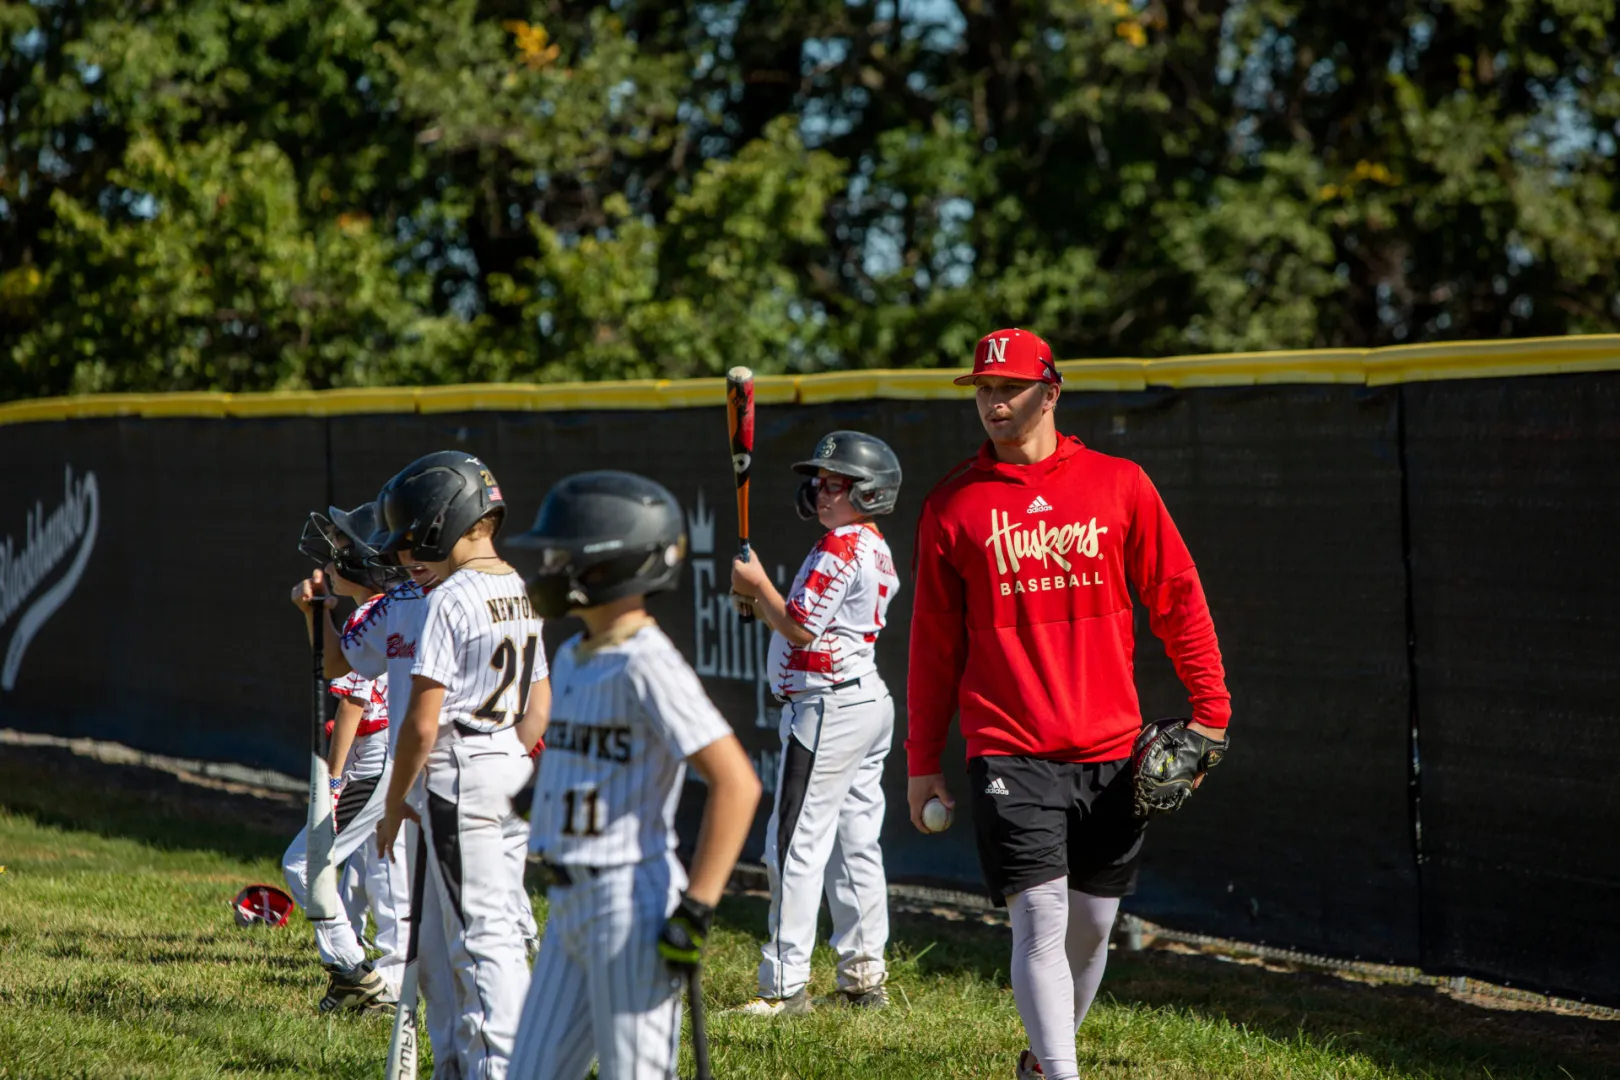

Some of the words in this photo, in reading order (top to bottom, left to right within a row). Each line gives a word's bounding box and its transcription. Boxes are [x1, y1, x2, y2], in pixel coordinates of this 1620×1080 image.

[984, 338, 1009, 364] N
[1027, 505, 1053, 515] adidas
[985, 509, 1108, 574] Huskers
[1001, 572, 1104, 596] BASEBALL
[473, 633, 539, 724] 21
[985, 786, 1009, 796] adidas
[561, 787, 601, 838] 11
